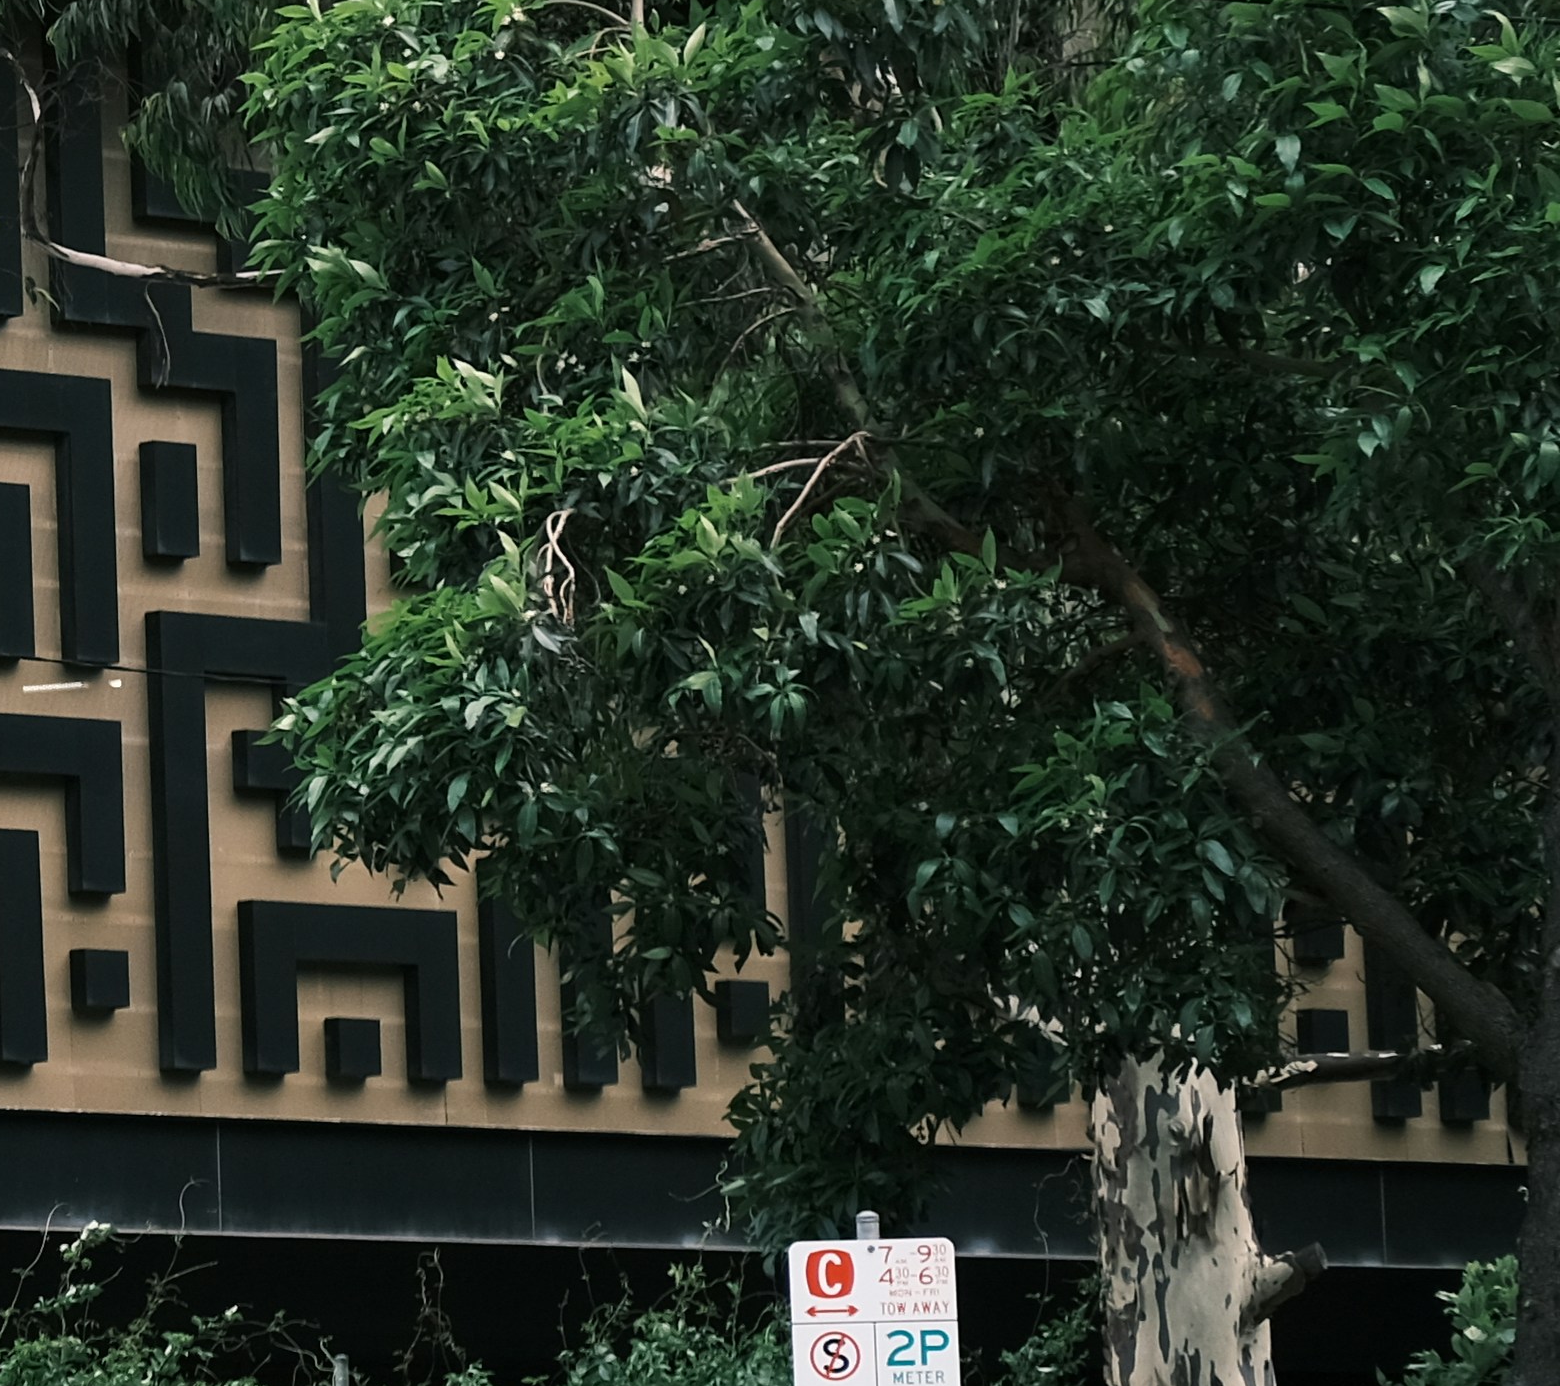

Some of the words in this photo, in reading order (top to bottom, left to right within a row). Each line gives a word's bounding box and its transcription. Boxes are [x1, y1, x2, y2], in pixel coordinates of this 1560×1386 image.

[818, 1252, 842, 1295] C
[880, 1302, 906, 1315] TOW
[912, 1301, 950, 1314] AWAY
[886, 1329, 950, 1367] 2P
[893, 1370, 945, 1385] METER
